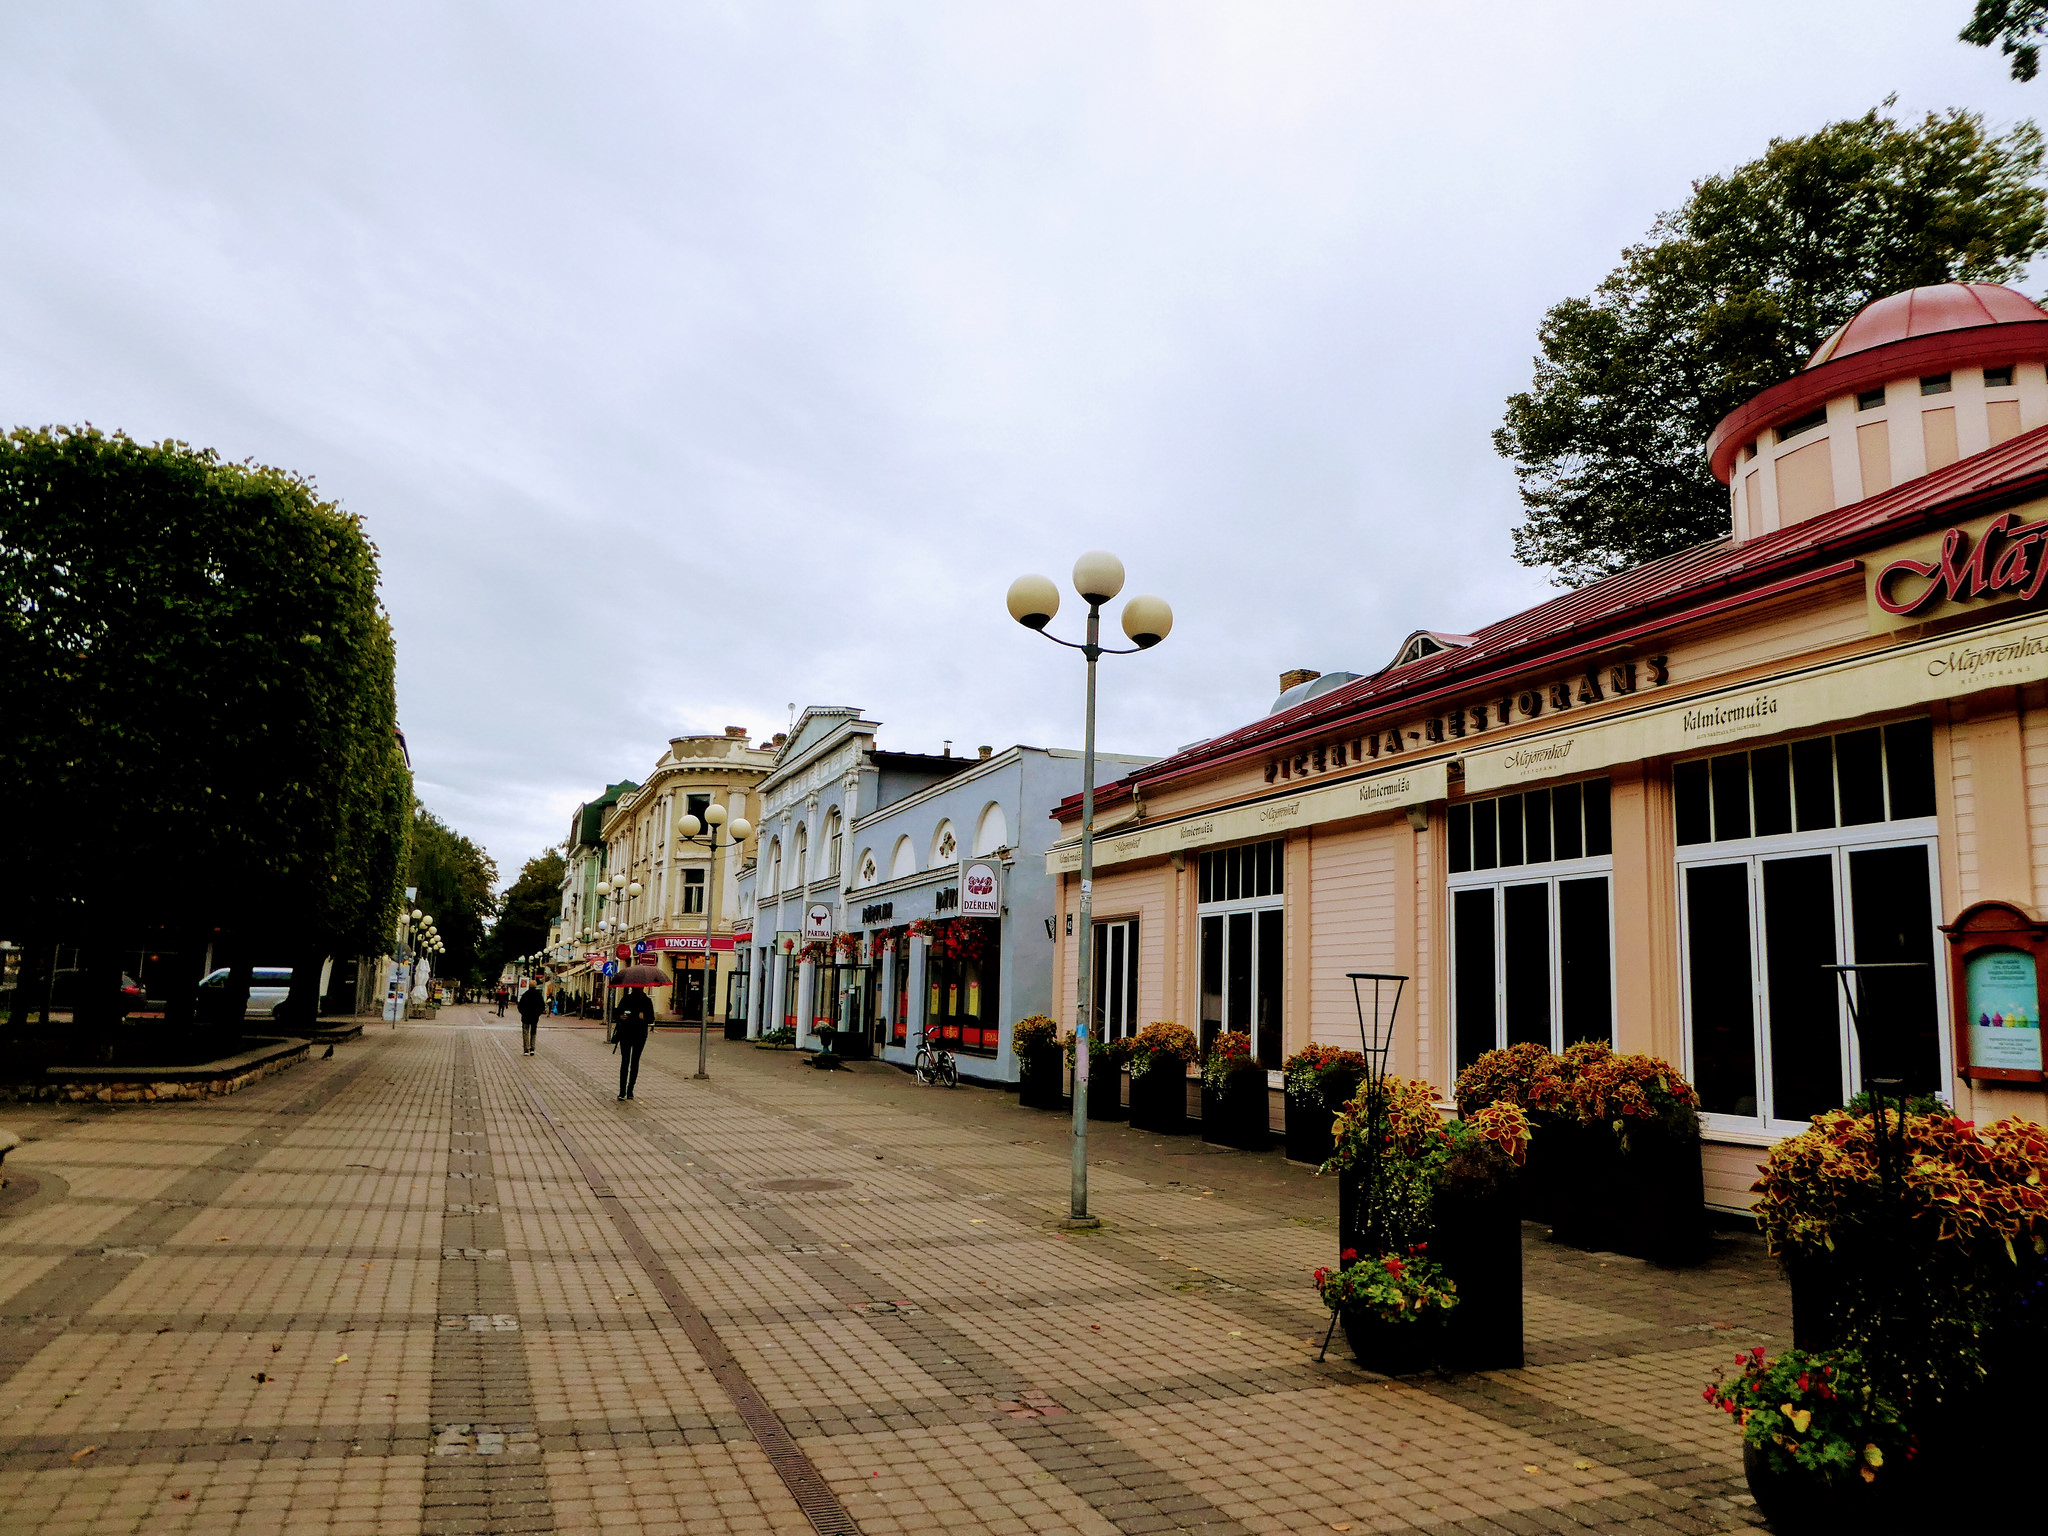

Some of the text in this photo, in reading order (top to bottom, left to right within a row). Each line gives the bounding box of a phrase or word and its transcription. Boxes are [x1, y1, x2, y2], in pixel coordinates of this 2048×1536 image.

[1683, 696, 1777, 732] Valmiermuiža
[964, 899, 996, 910] DZĒRIENI
[664, 938, 711, 948] VINOTEKA
